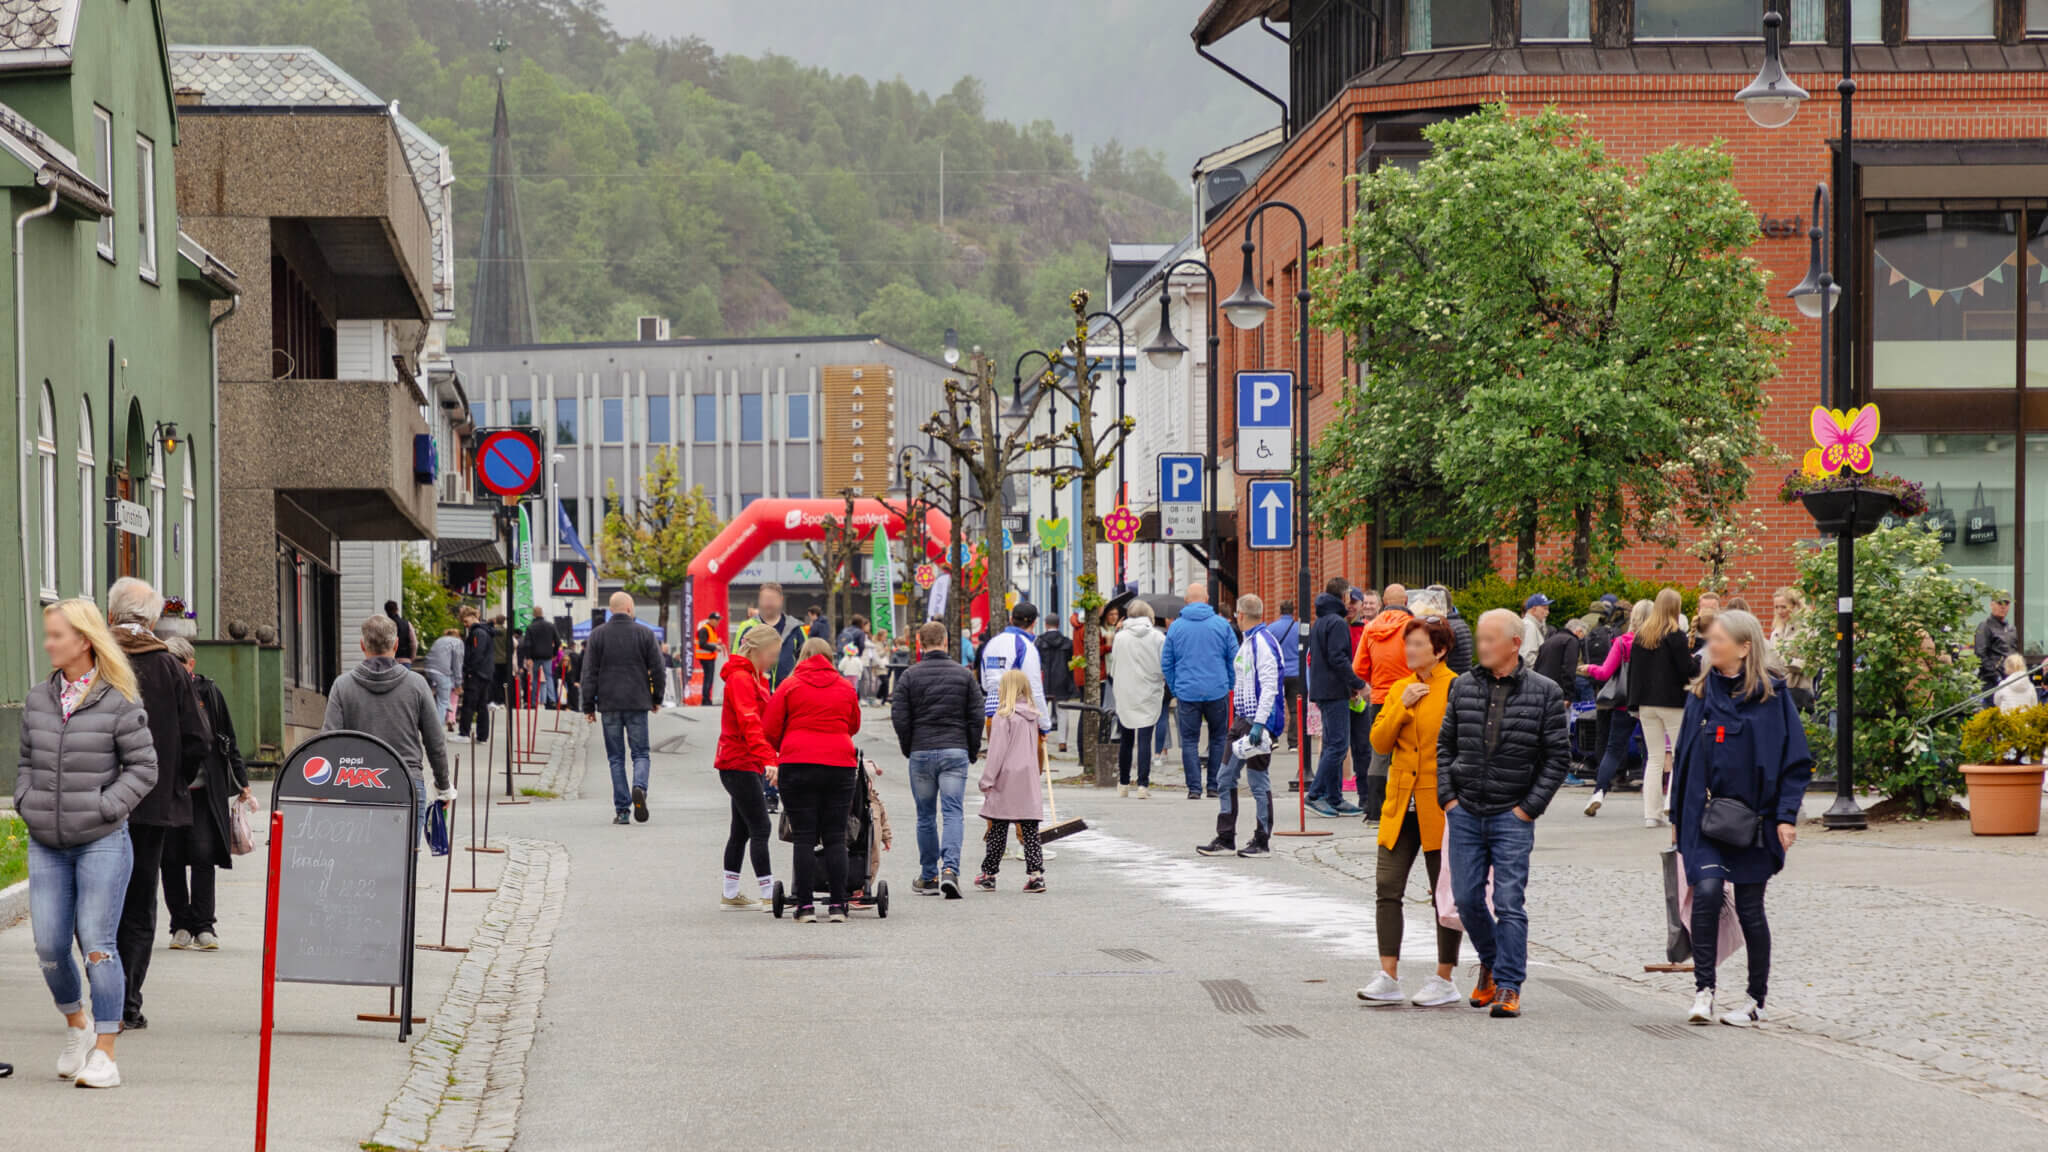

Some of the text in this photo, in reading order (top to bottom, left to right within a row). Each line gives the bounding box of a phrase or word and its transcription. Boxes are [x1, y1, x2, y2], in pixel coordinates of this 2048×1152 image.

[1253, 382, 1280, 422] P
[1172, 463, 1194, 498] P
[339, 757, 364, 766] pepsi
[333, 767, 389, 788] MAX
